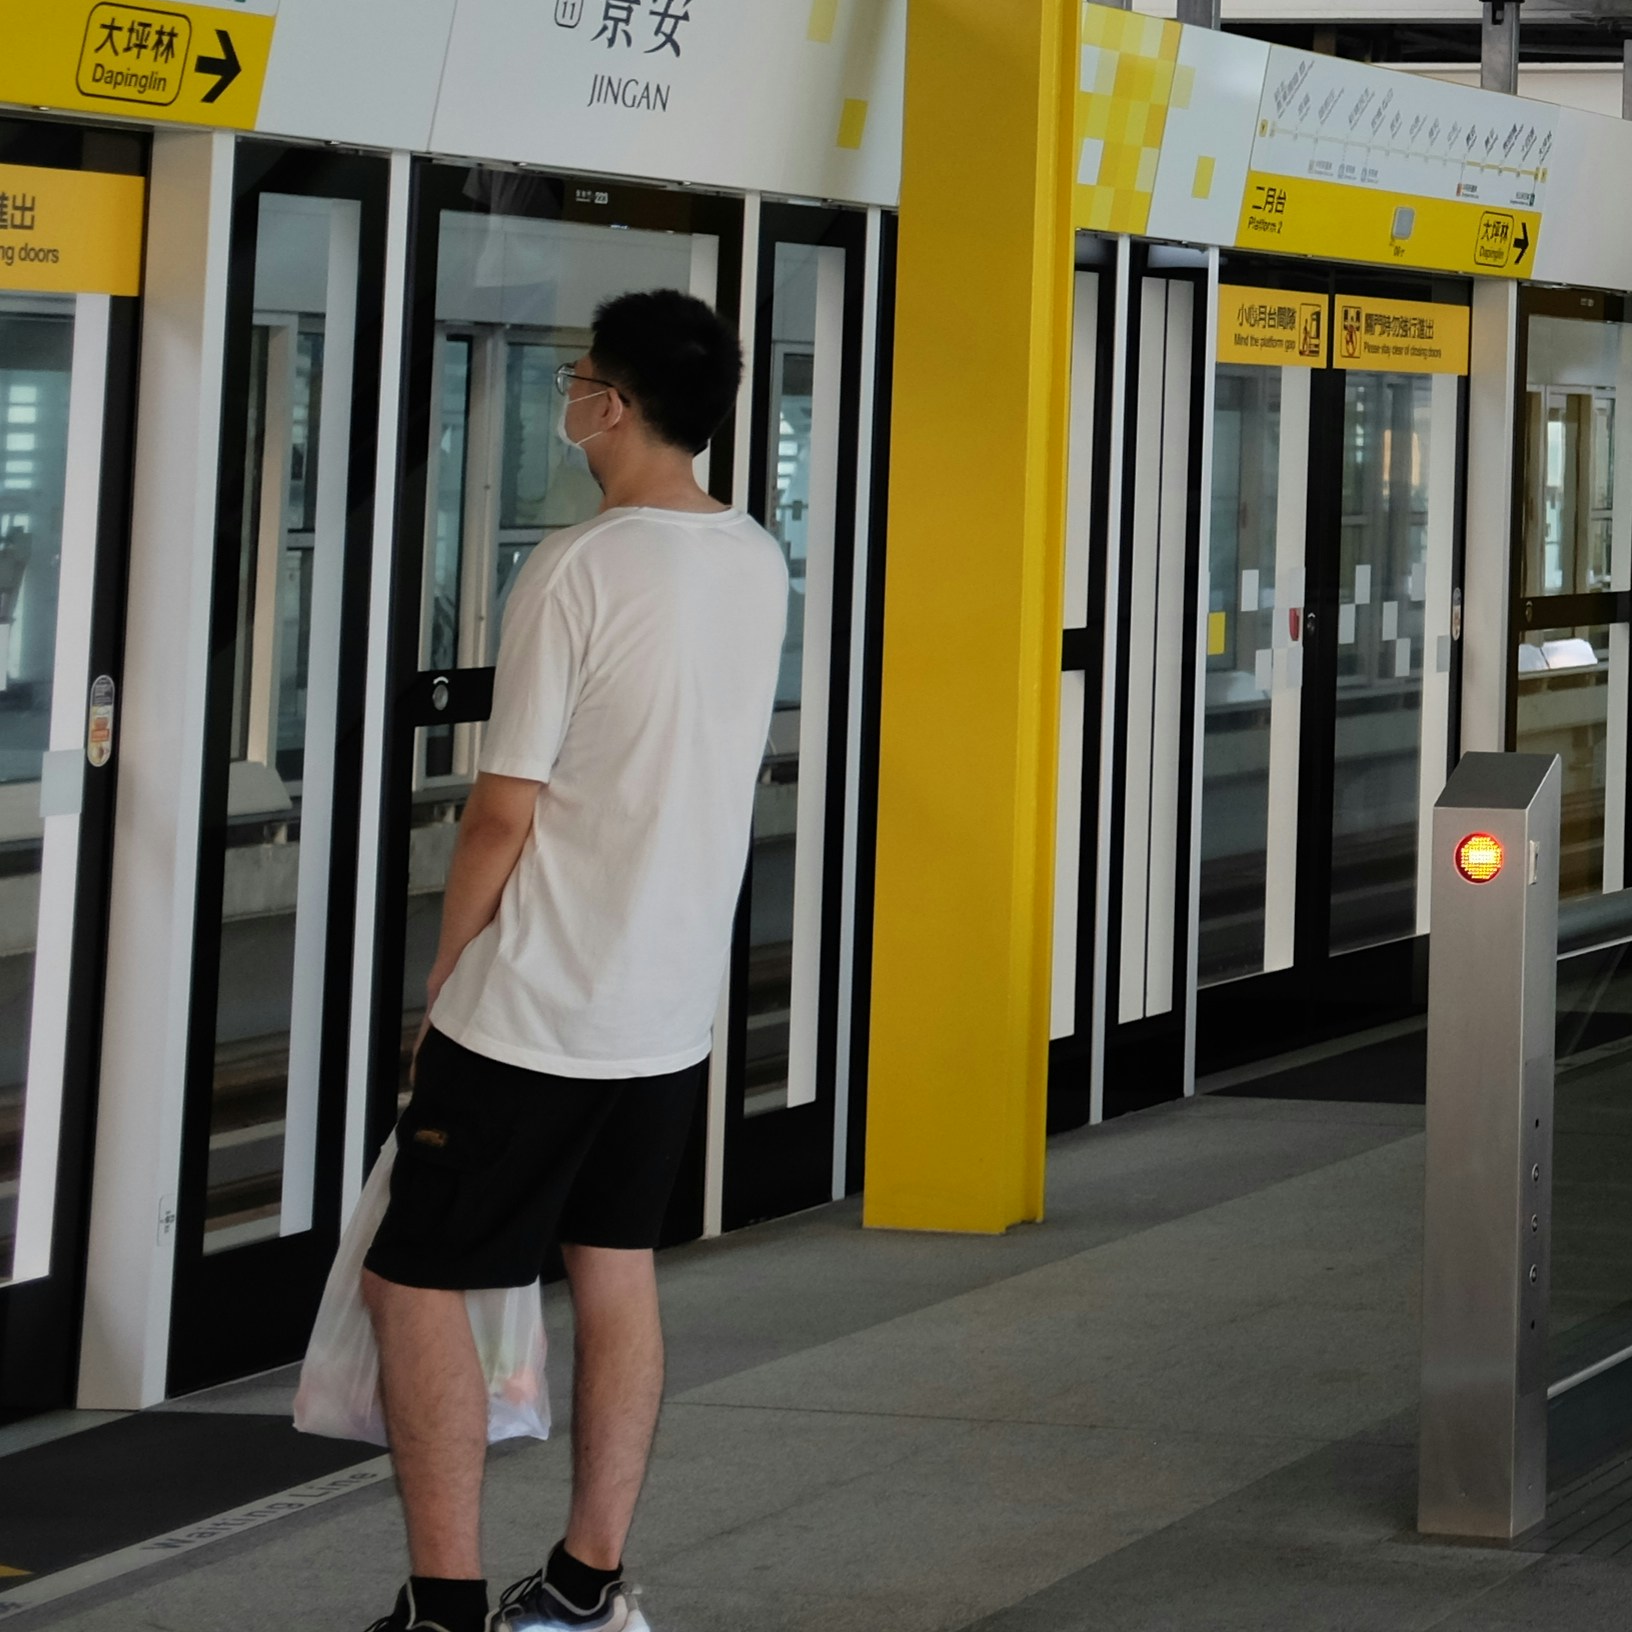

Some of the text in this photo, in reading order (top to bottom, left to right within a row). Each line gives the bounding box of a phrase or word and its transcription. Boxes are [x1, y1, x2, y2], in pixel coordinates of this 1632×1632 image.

[562, 0, 576, 20] 11
[94, 17, 178, 64] 大坪林
[92, 63, 167, 93] Dapinglin
[587, 73, 671, 112] JINGAN
[1252, 185, 1288, 215] 二月台
[1481, 219, 1509, 244] 大坪林
[18, 242, 60, 264] doors
[141, 1470, 377, 1552] Waiting Line
